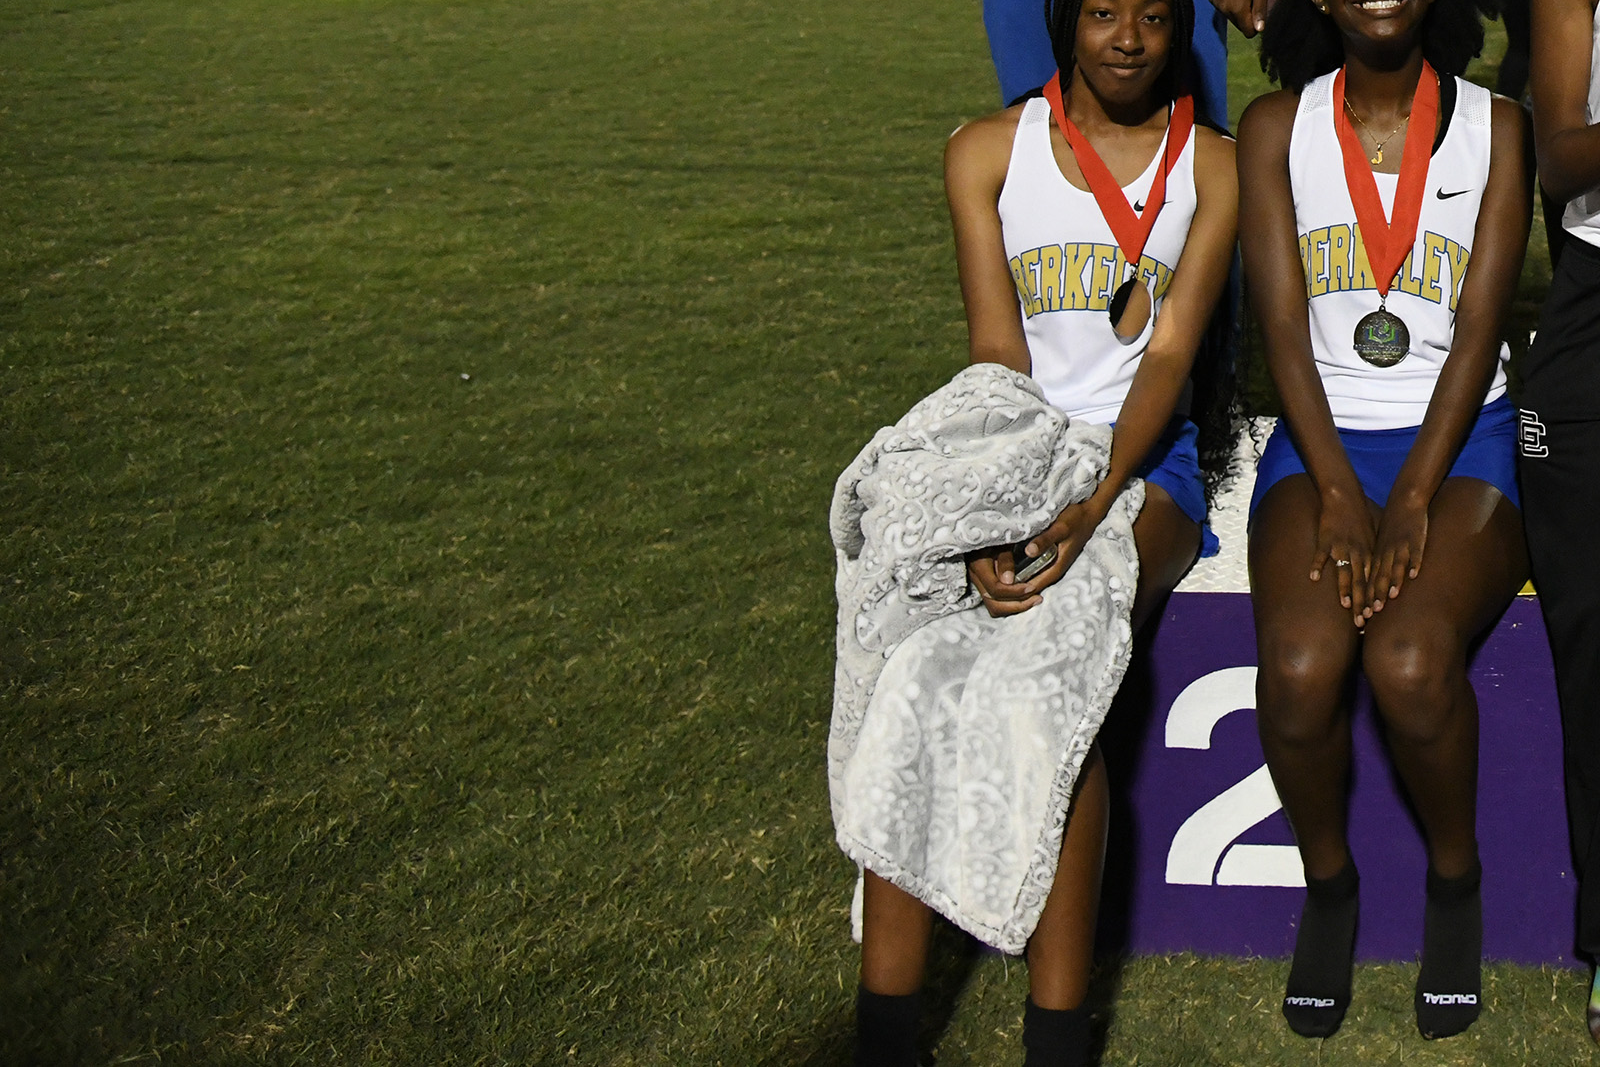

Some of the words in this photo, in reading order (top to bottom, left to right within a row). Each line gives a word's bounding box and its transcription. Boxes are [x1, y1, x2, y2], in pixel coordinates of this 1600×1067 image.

[1299, 222, 1471, 314] BERLEY
[1164, 666, 1308, 888] 2
[1285, 996, 1335, 1008] CRUCIAL
[1422, 992, 1478, 1005] CRUCIAL
